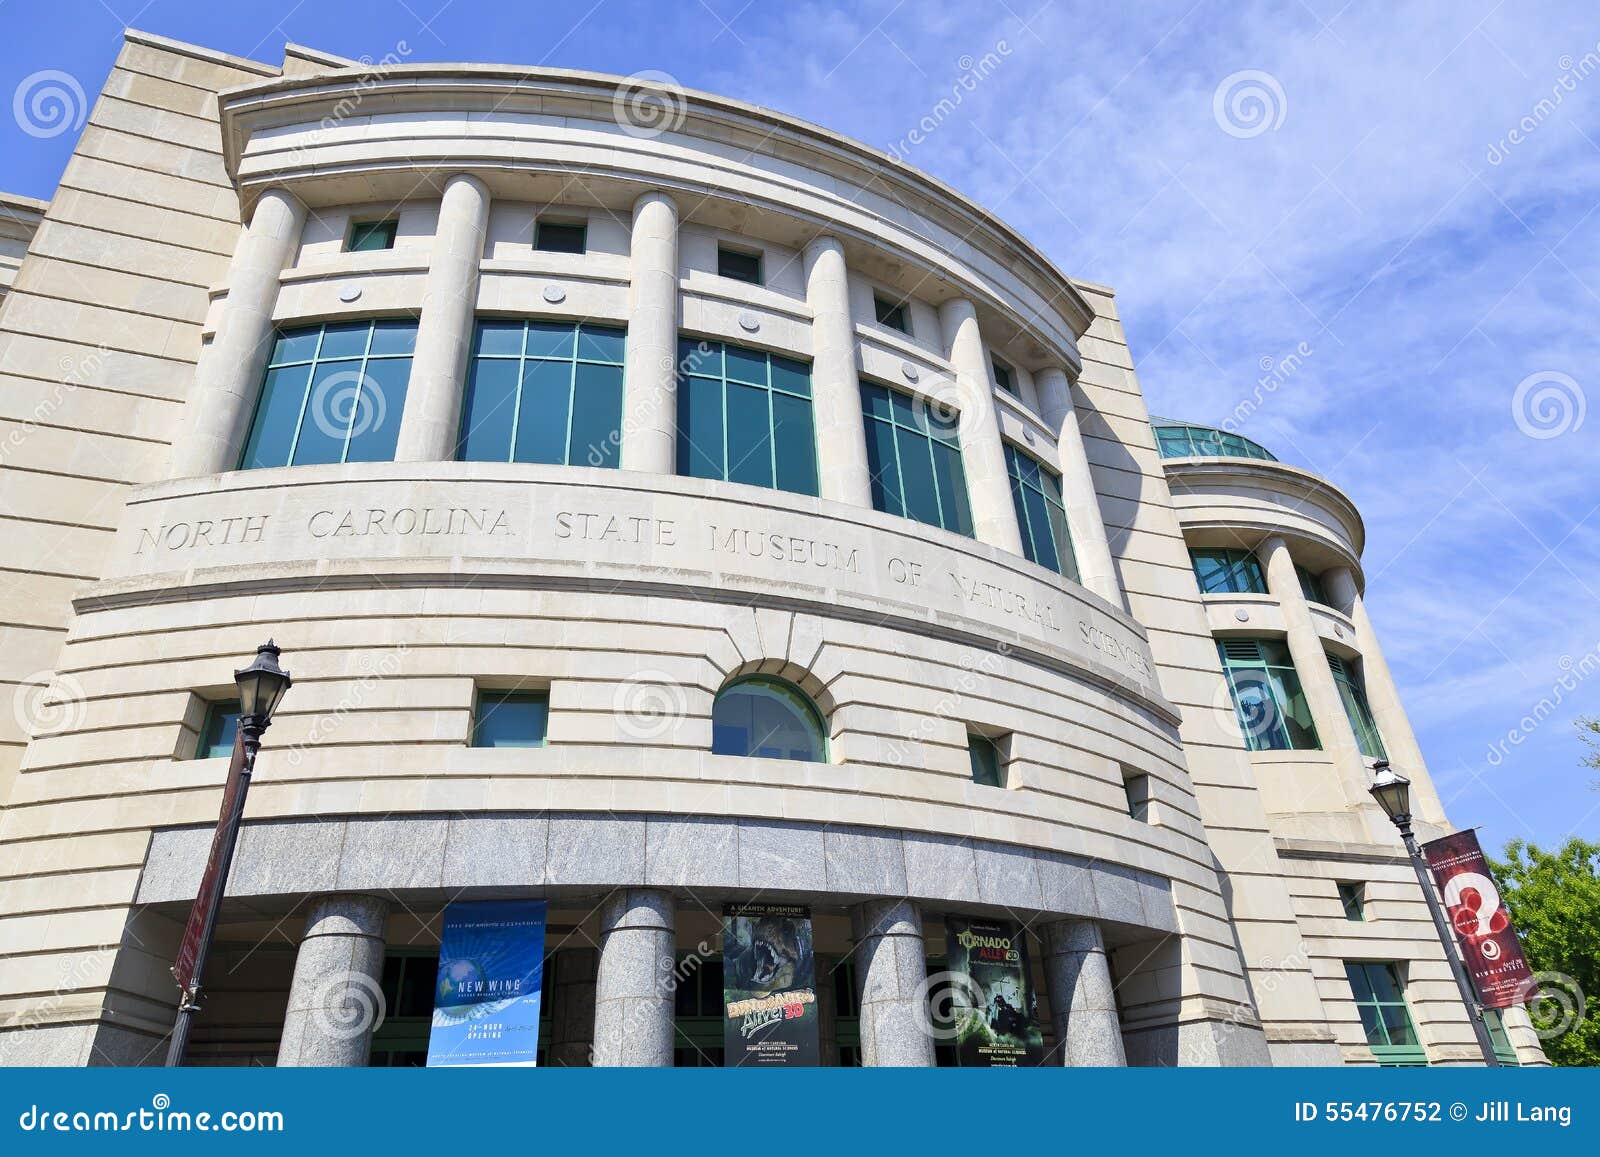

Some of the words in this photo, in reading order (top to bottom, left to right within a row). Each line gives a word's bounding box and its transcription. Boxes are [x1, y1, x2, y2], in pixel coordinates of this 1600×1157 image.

[135, 514, 269, 556] NORTH
[307, 508, 516, 539] CAROLINA
[553, 511, 677, 547] STATE
[708, 526, 860, 574] MUSEUM
[888, 557, 923, 588] OF
[949, 571, 1062, 633] NATURAL
[1078, 620, 1154, 680] SCIENCES
[956, 930, 1011, 949] TORNADO
[980, 948, 1008, 960] ALLEY
[1007, 950, 1019, 960] 3D
[458, 981, 484, 993] NEW
[489, 979, 521, 991] WING
[784, 1002, 804, 1020] 3D
[467, 1031, 502, 1040] OPENING
